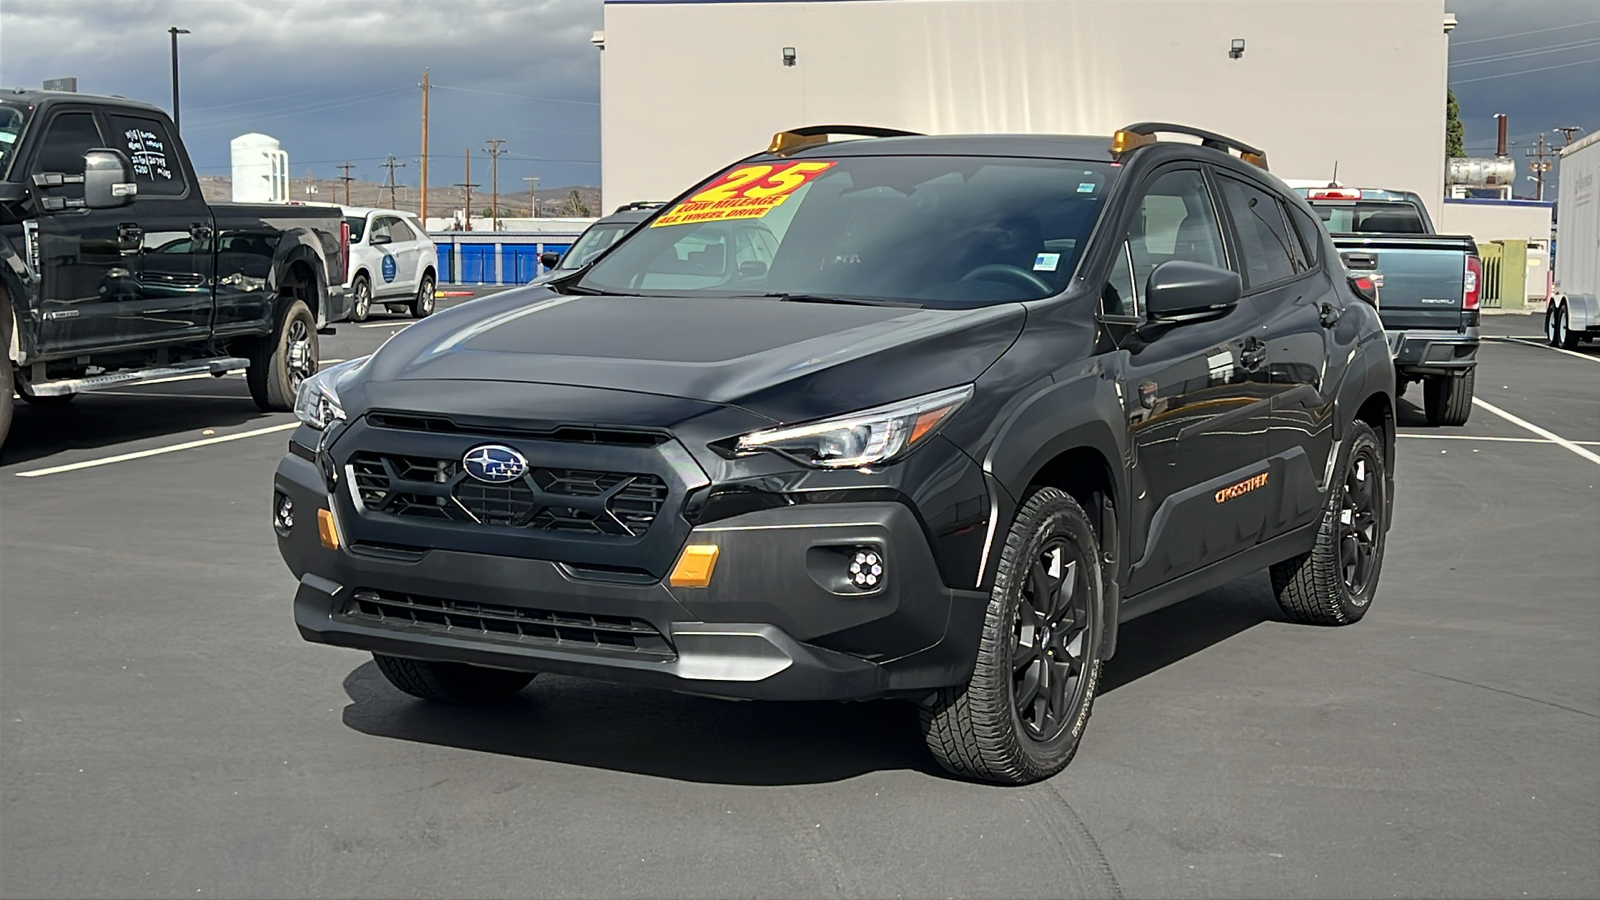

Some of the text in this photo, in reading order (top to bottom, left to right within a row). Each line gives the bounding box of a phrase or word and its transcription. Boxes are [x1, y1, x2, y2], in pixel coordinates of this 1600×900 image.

[691, 162, 831, 203] 25
[656, 207, 769, 224] ALL WHEEL DRIVE
[676, 195, 781, 213] LOW MILEAGE
[1215, 472, 1269, 504] CROSSTREK
